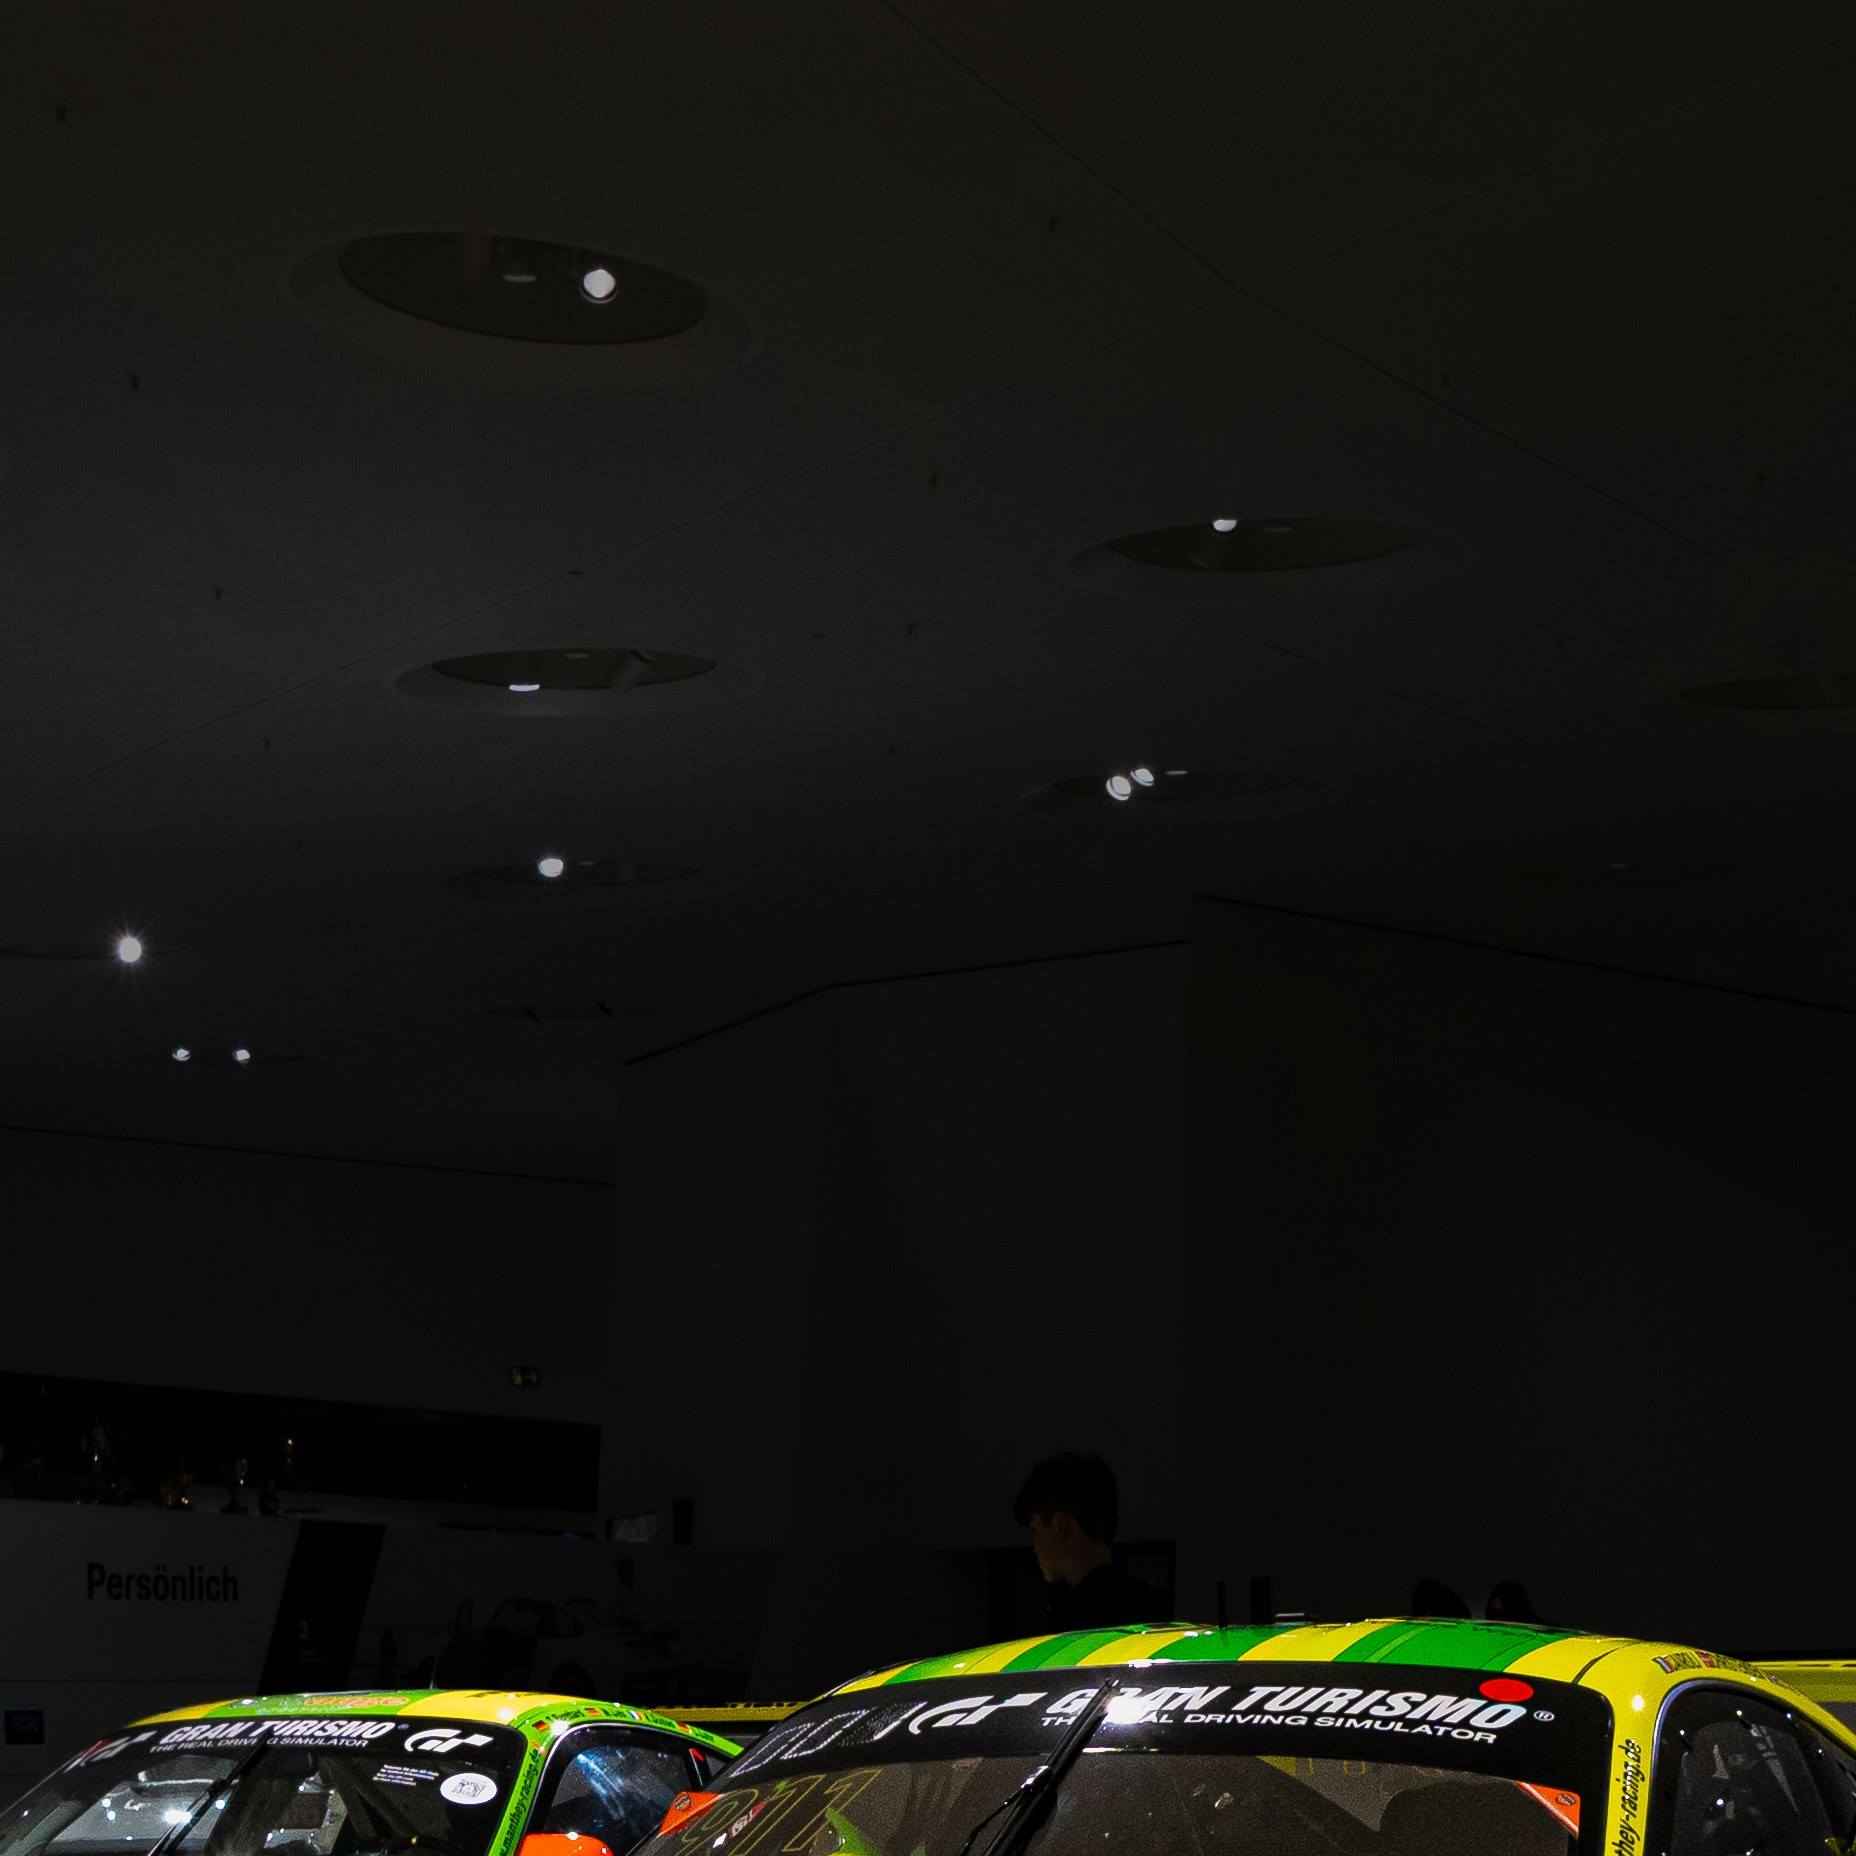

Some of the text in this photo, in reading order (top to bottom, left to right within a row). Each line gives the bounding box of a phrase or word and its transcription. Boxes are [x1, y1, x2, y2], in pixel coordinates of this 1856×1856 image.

[86, 1562, 239, 1602] Persönlich
[298, 1621, 310, 1640] 3
[1231, 1685, 1526, 1728] TURISMO
[159, 1720, 396, 1745] GRAN TURISMO
[1183, 1713, 1307, 1727] DRIVING
[1314, 1717, 1497, 1744] SIMULATOR
[149, 1737, 368, 1754] THE REAL DRIVIG SIMULATOR
